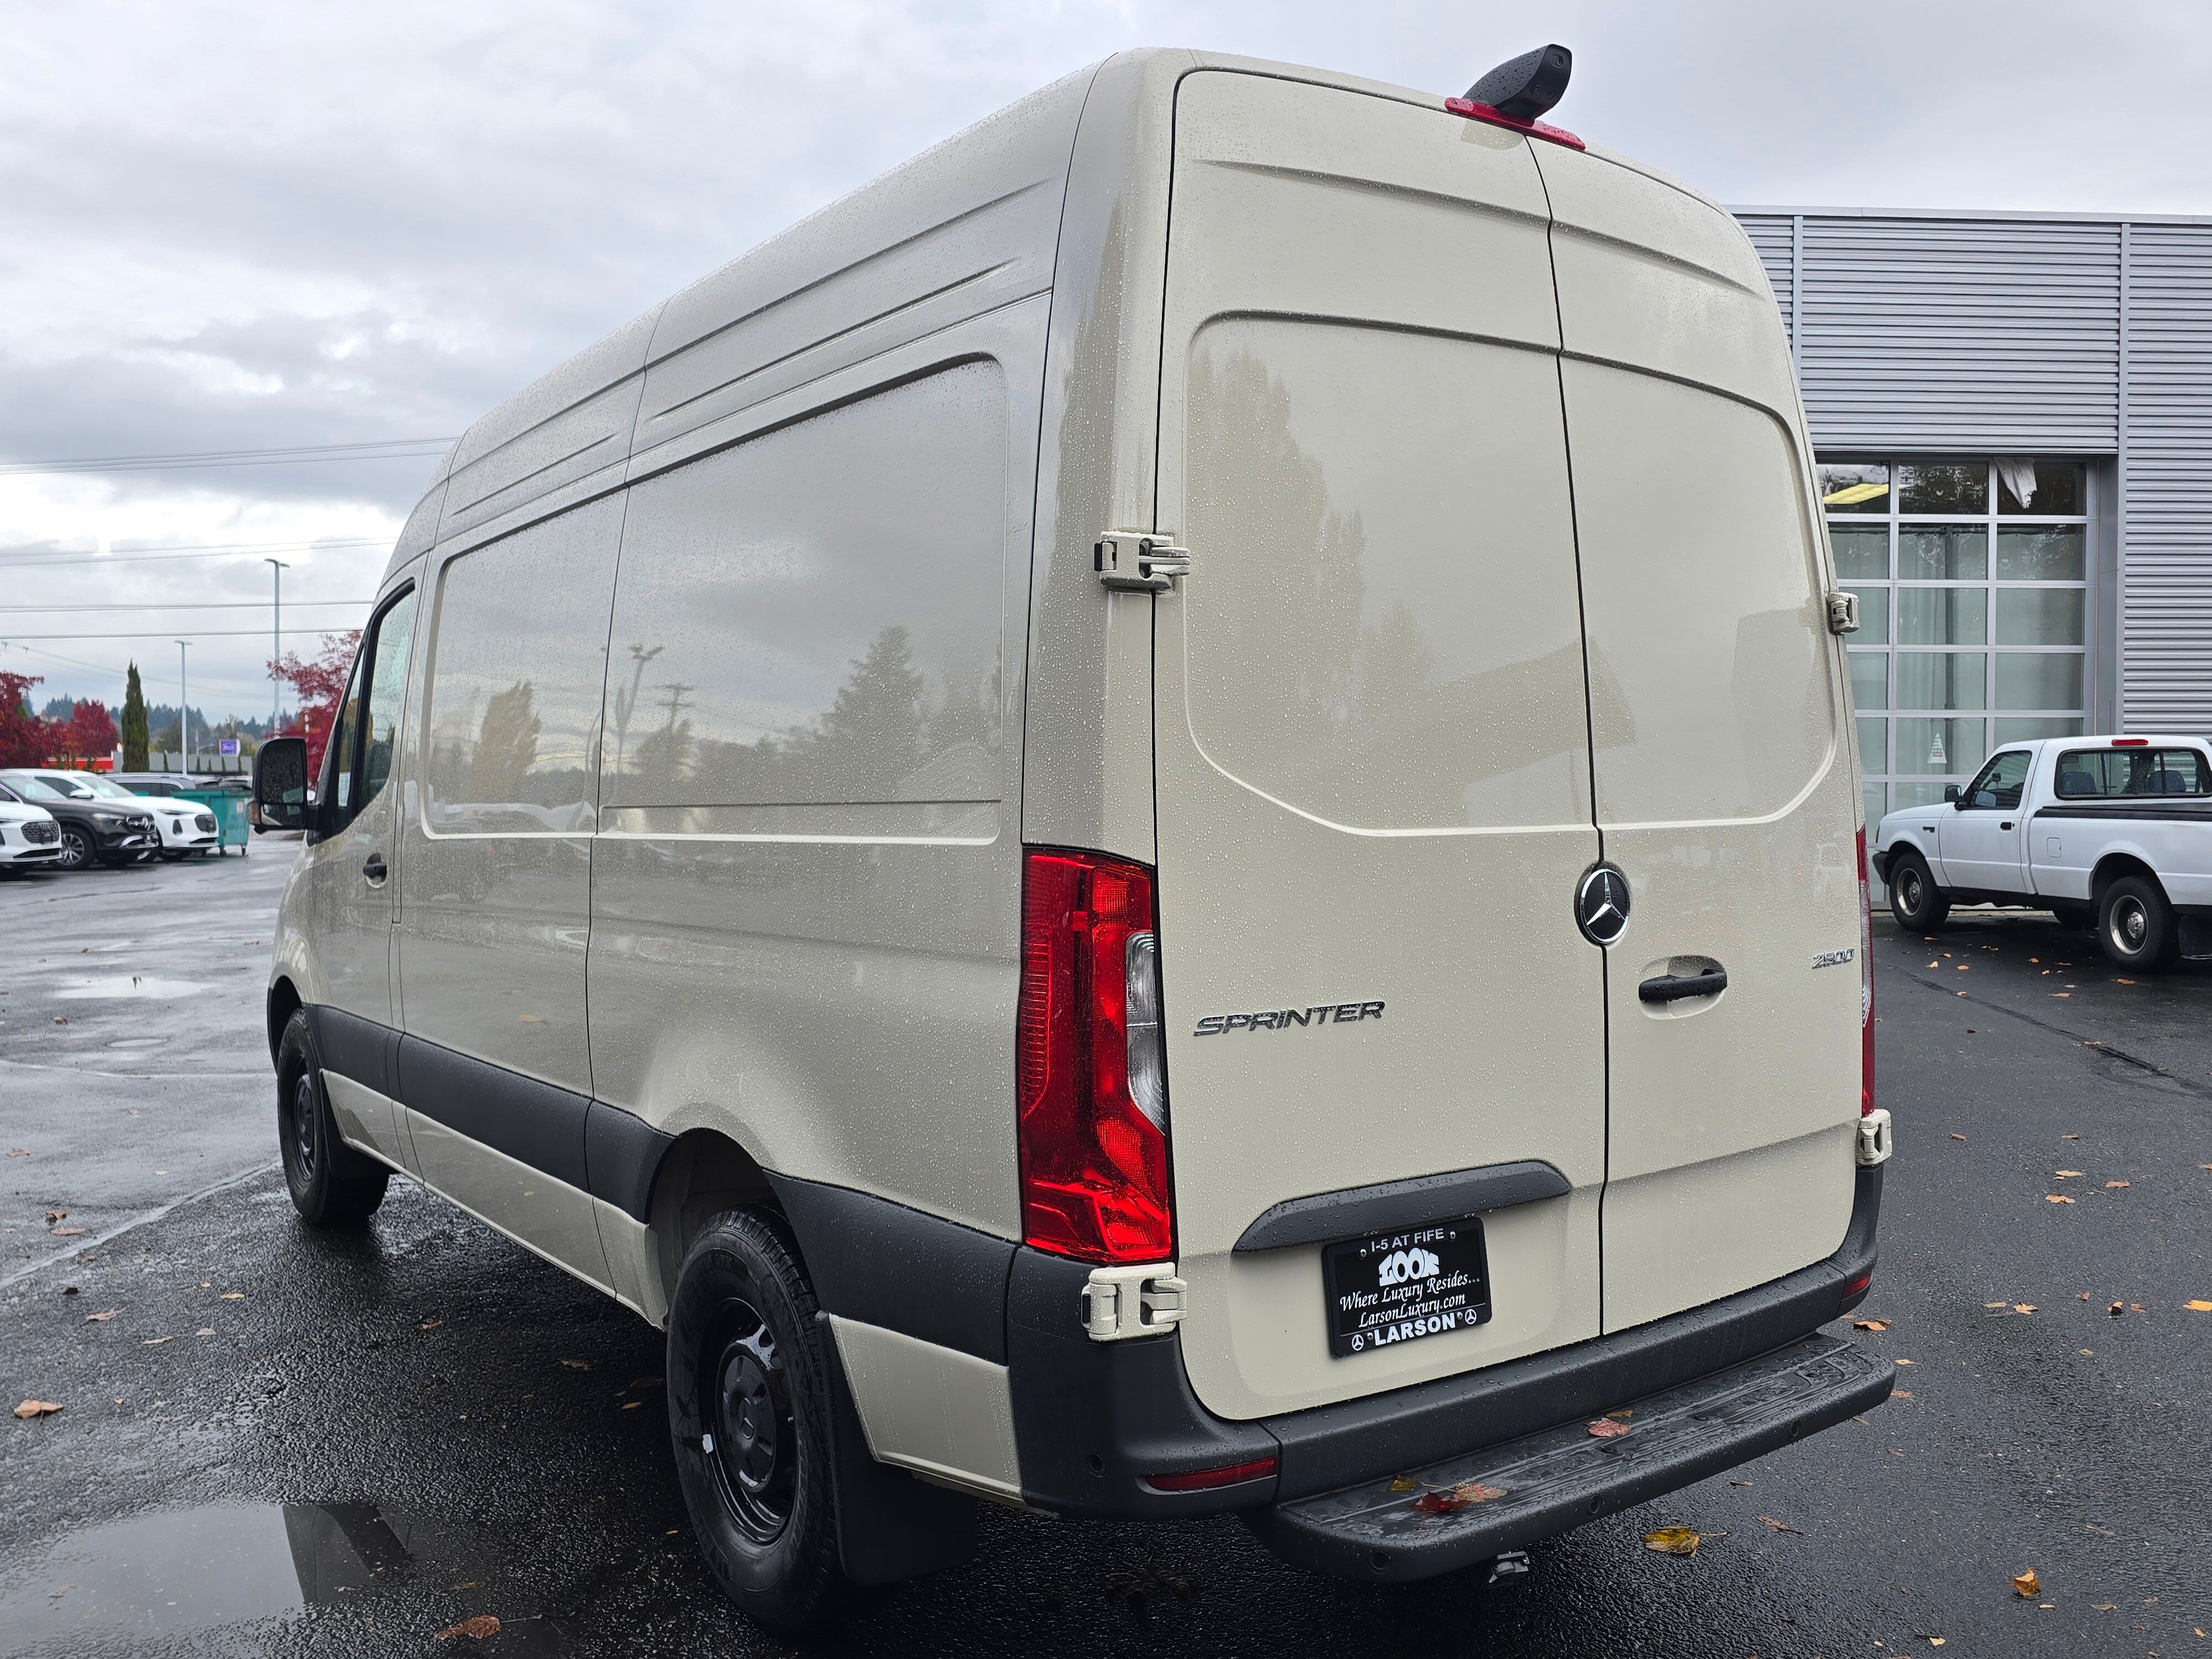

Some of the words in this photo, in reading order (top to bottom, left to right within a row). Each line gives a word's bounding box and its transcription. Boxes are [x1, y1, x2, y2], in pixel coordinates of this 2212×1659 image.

[1812, 947, 1855, 969] 2500
[1193, 1000, 1385, 1036] SPRINTER
[1371, 1239, 1388, 1252] I-5
[1391, 1234, 1410, 1249] AT
[1414, 1228, 1444, 1244] FIFE
[1378, 1247, 1439, 1286] LOOK
[1340, 1292, 1378, 1312] Where
[1381, 1283, 1423, 1303] Luxury
[1359, 1293, 1465, 1328] LarsonLuxury.com
[1374, 1312, 1456, 1346] LARSON
